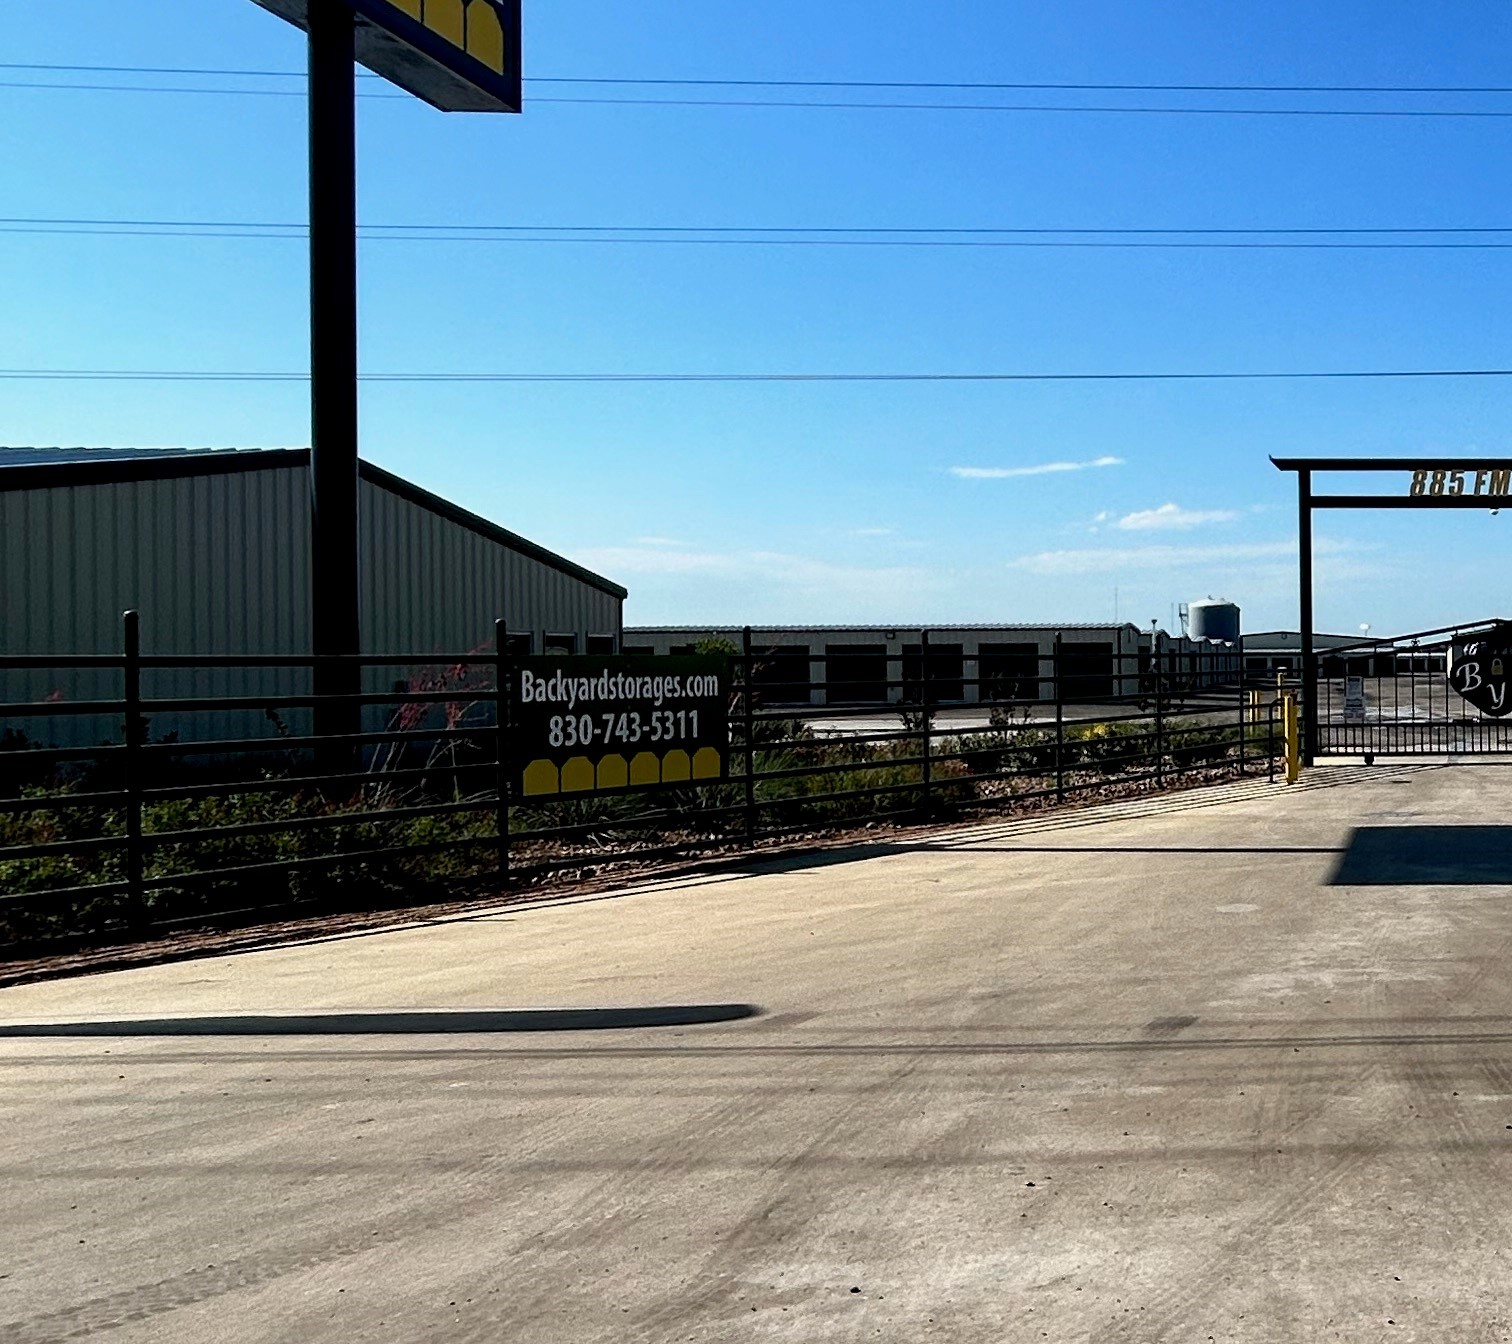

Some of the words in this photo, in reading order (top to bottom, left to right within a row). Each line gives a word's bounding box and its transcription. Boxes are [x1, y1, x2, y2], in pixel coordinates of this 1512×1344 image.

[1410, 469, 1465, 497] 885
[1474, 469, 1512, 497] FM
[521, 668, 719, 710] Backyardstorages.com
[549, 709, 698, 747] 830-743-5311
